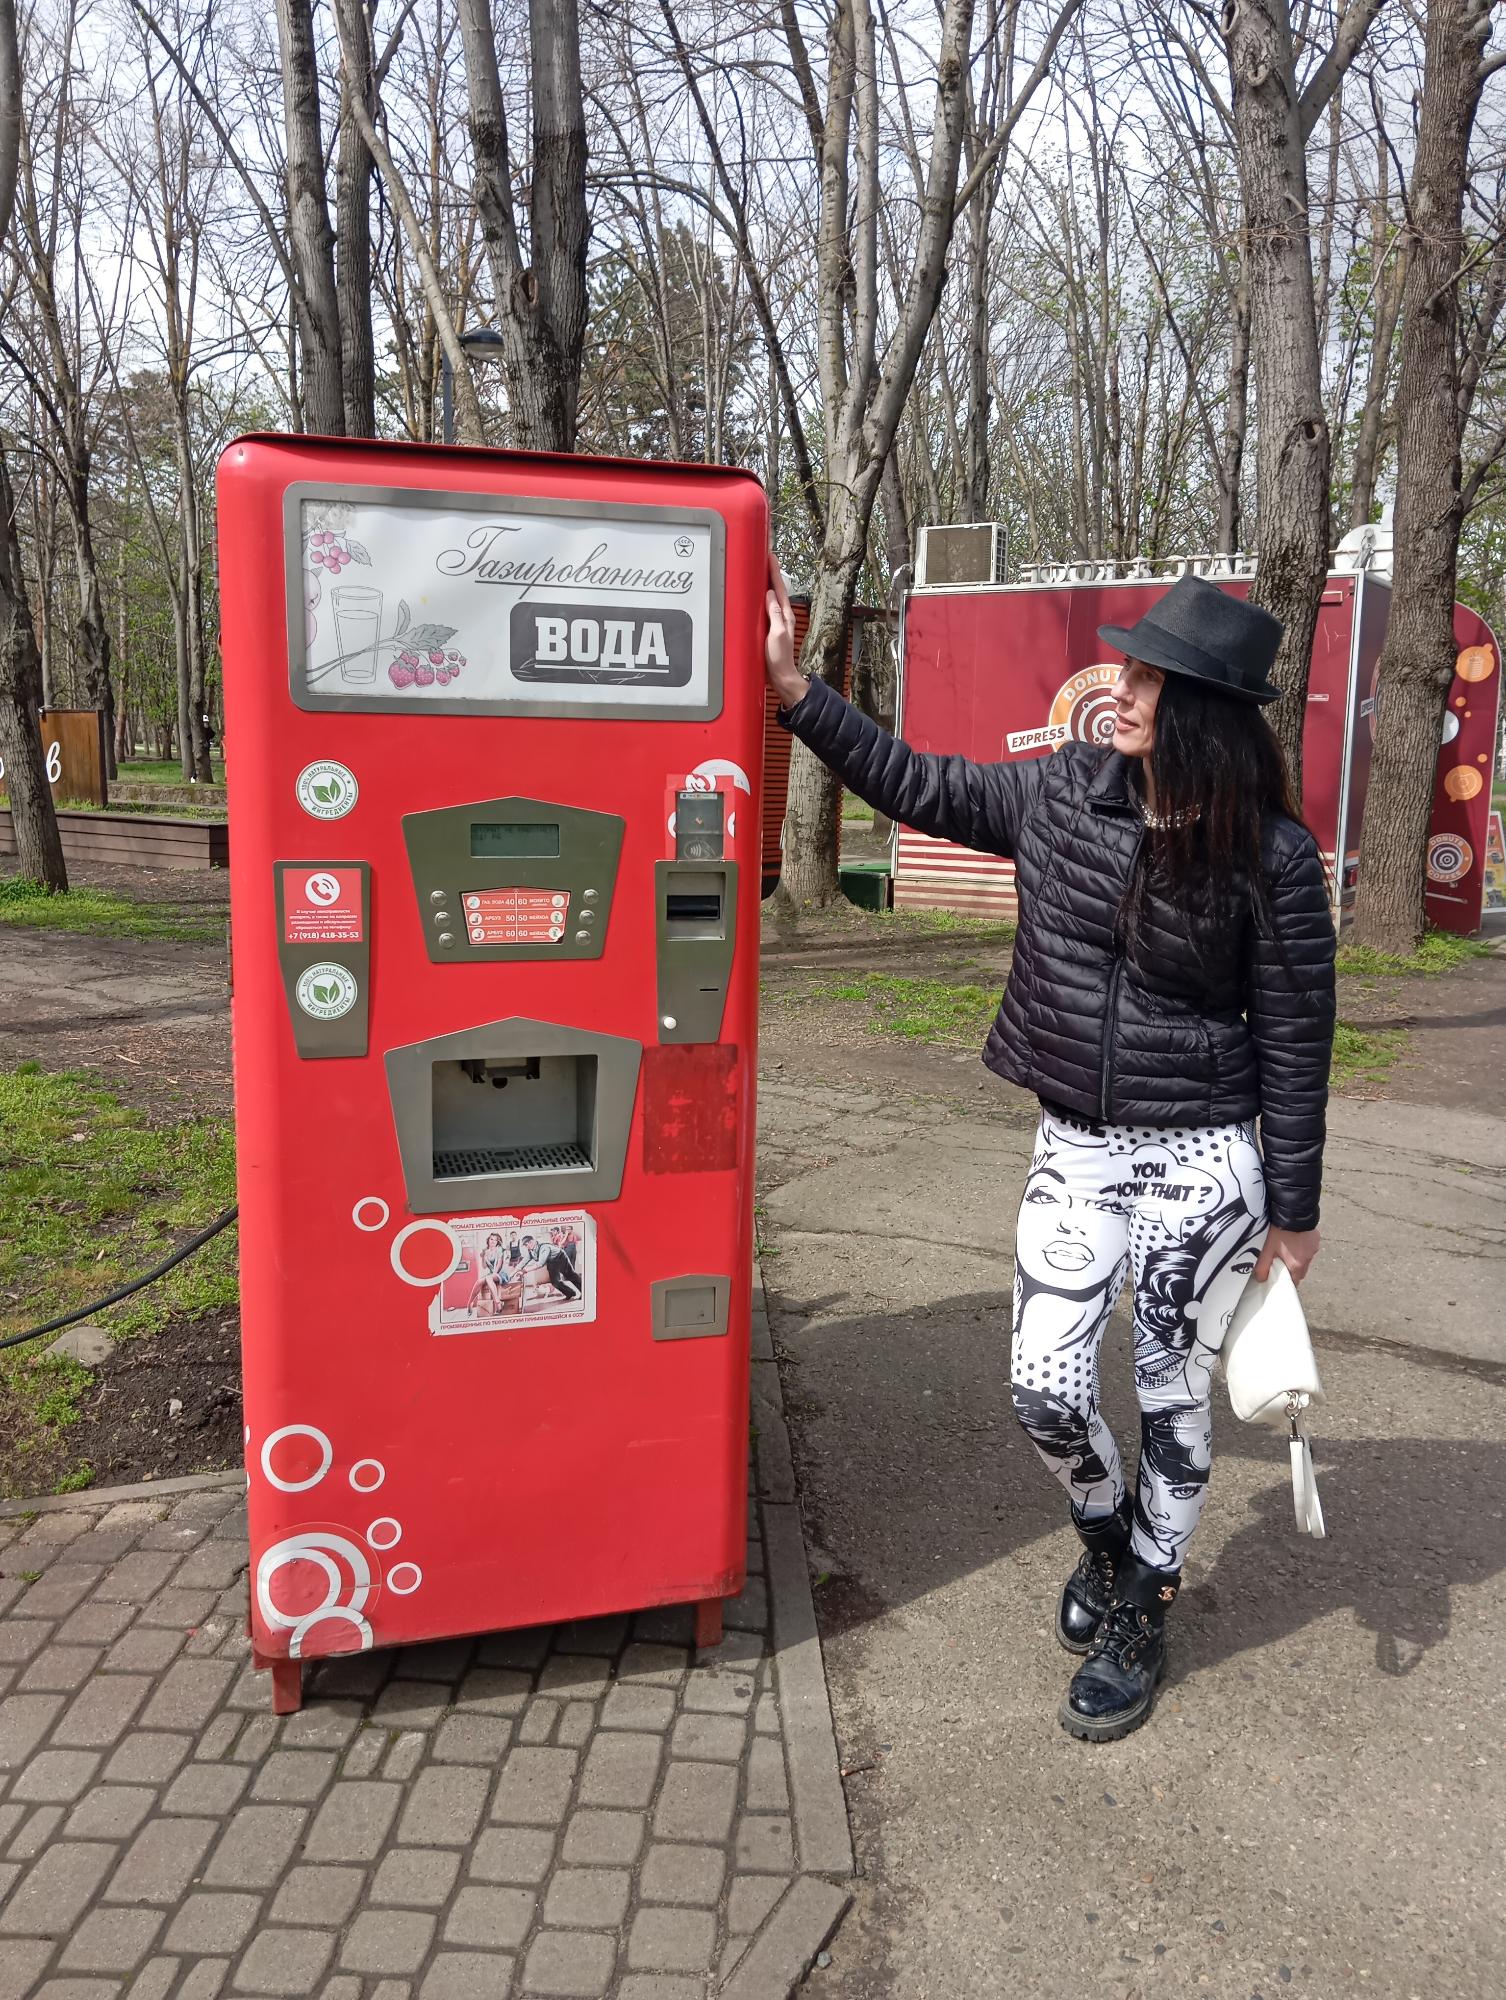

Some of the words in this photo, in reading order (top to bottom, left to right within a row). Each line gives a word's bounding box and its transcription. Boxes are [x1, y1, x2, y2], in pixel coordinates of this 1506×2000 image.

[436, 525, 694, 600] Газированная
[535, 616, 670, 669] ВОДА
[1063, 668, 1122, 702] DONUT
[1011, 727, 1066, 749] EXPRESS
[1131, 1161, 1167, 1178] YOU
[1151, 1182, 1195, 1202] THAT
